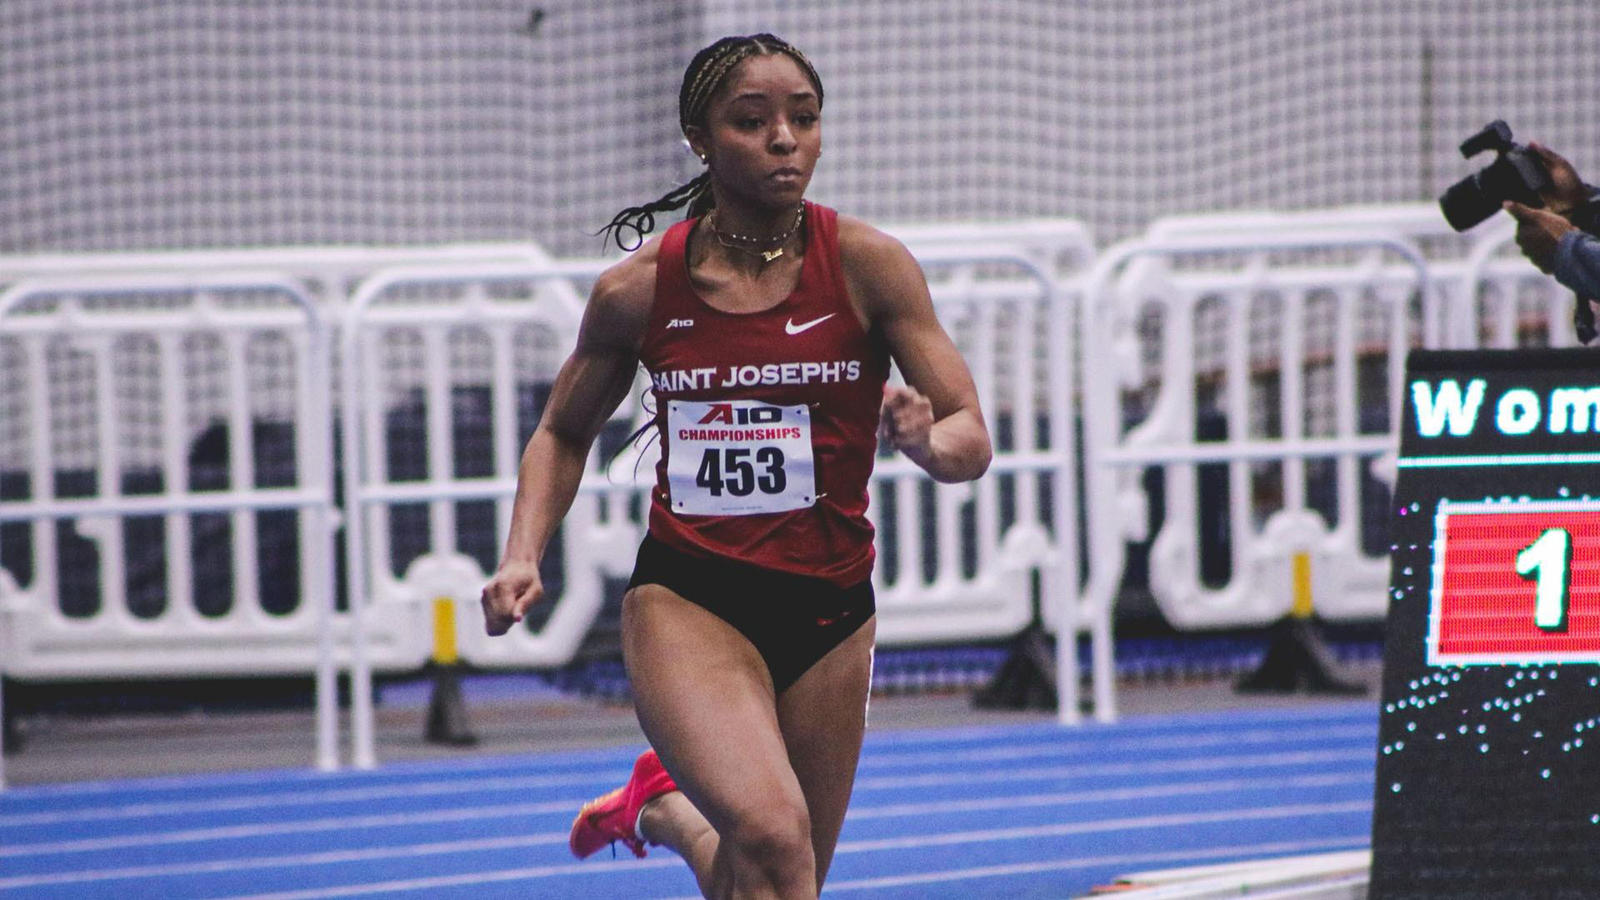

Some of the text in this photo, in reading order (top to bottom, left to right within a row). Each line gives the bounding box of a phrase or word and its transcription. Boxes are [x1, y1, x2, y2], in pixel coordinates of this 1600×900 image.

[665, 319, 694, 329] A10
[721, 360, 861, 387] JOSEPH'S
[697, 403, 783, 425] A10
[1411, 378, 1600, 437] Wom
[678, 427, 801, 442] CHAMPIONSHIPS
[696, 446, 787, 497] 453
[1516, 528, 1569, 628] 1
